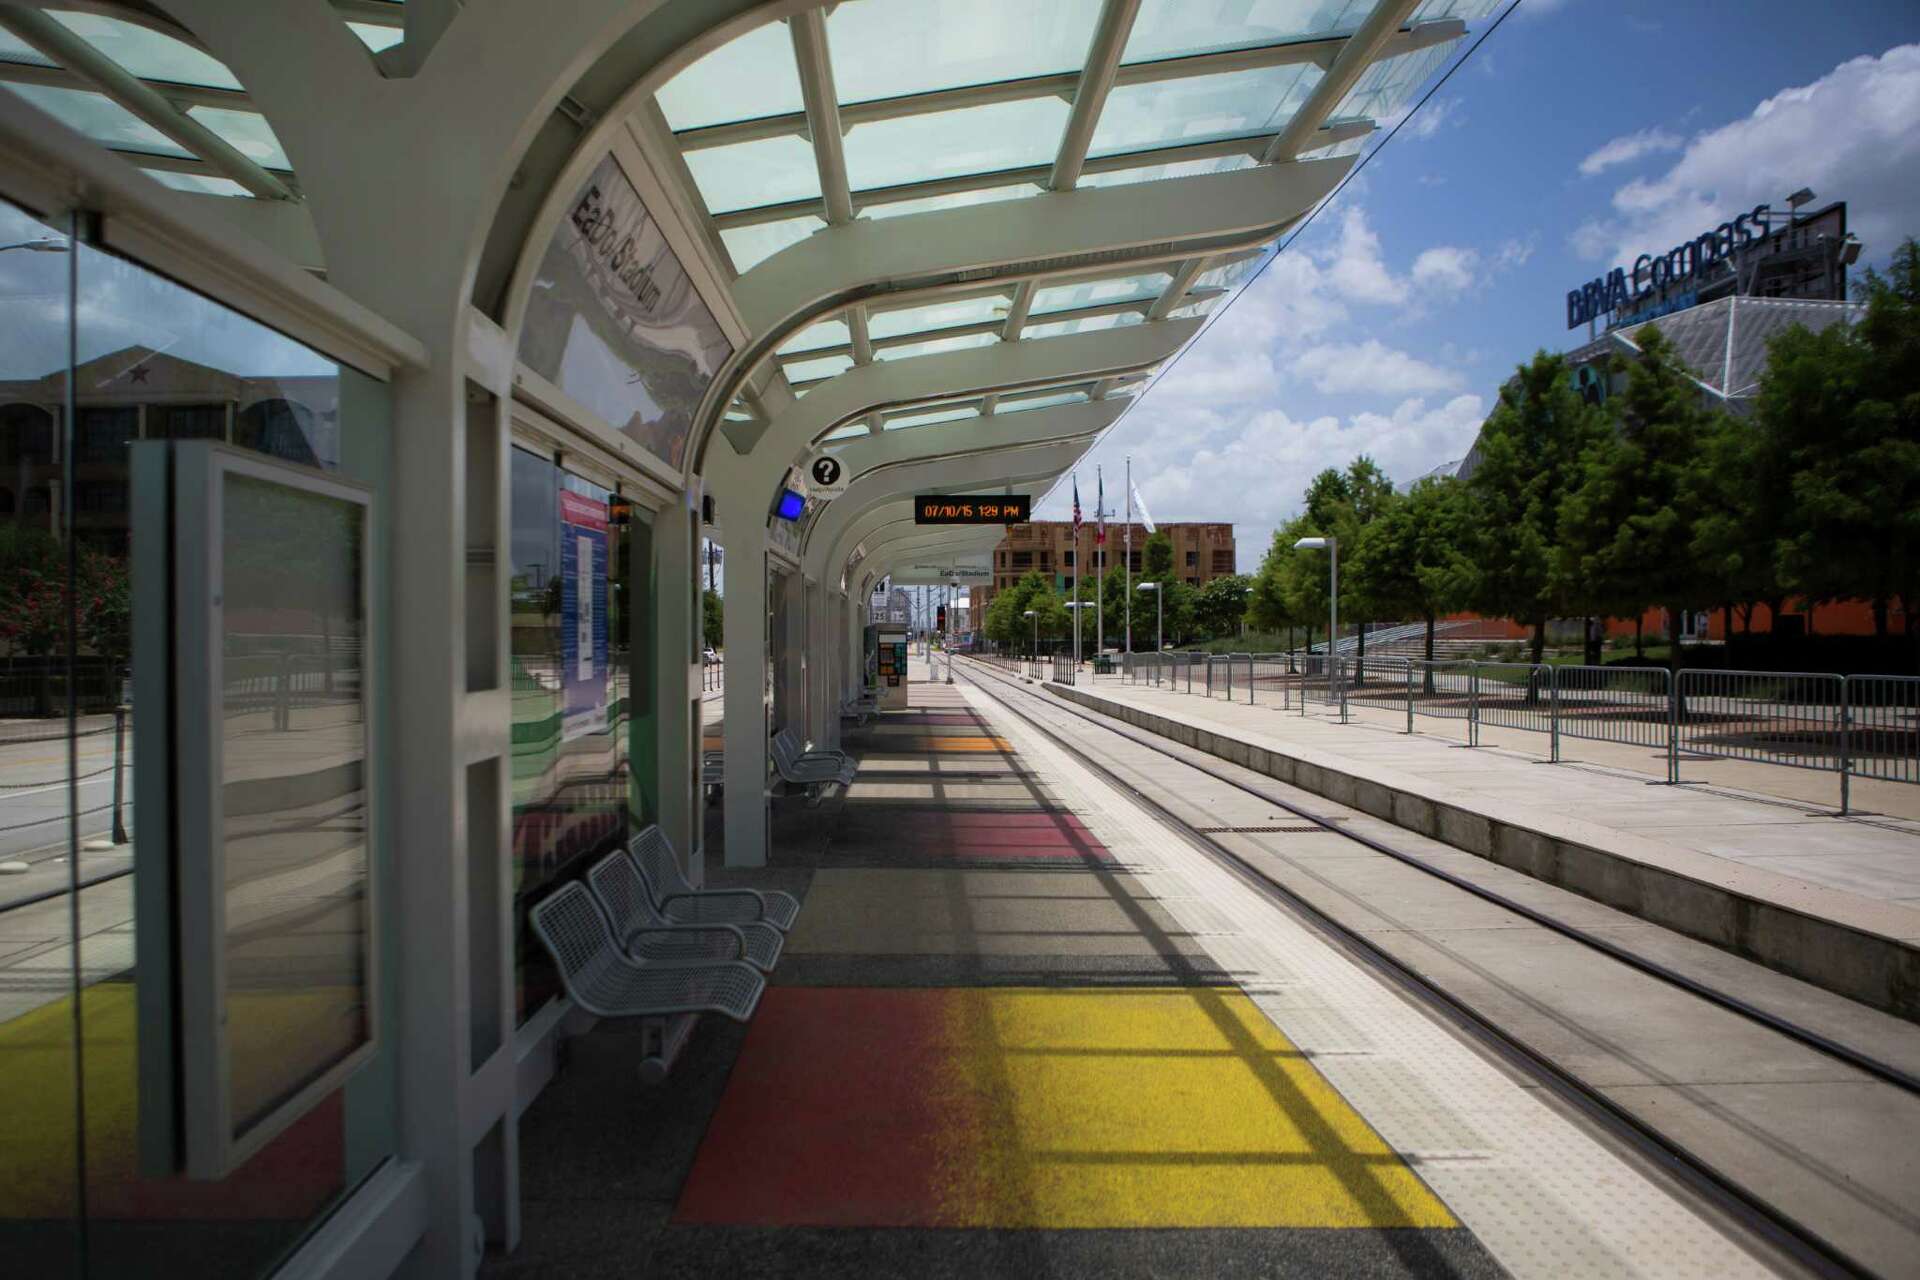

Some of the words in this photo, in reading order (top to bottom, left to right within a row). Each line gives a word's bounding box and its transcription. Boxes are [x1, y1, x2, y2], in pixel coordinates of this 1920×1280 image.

[1568, 266, 1628, 330] BBVA
[1633, 204, 1770, 298] Compass
[924, 505, 973, 518] 07/10/15
[1003, 505, 1019, 518] PM
